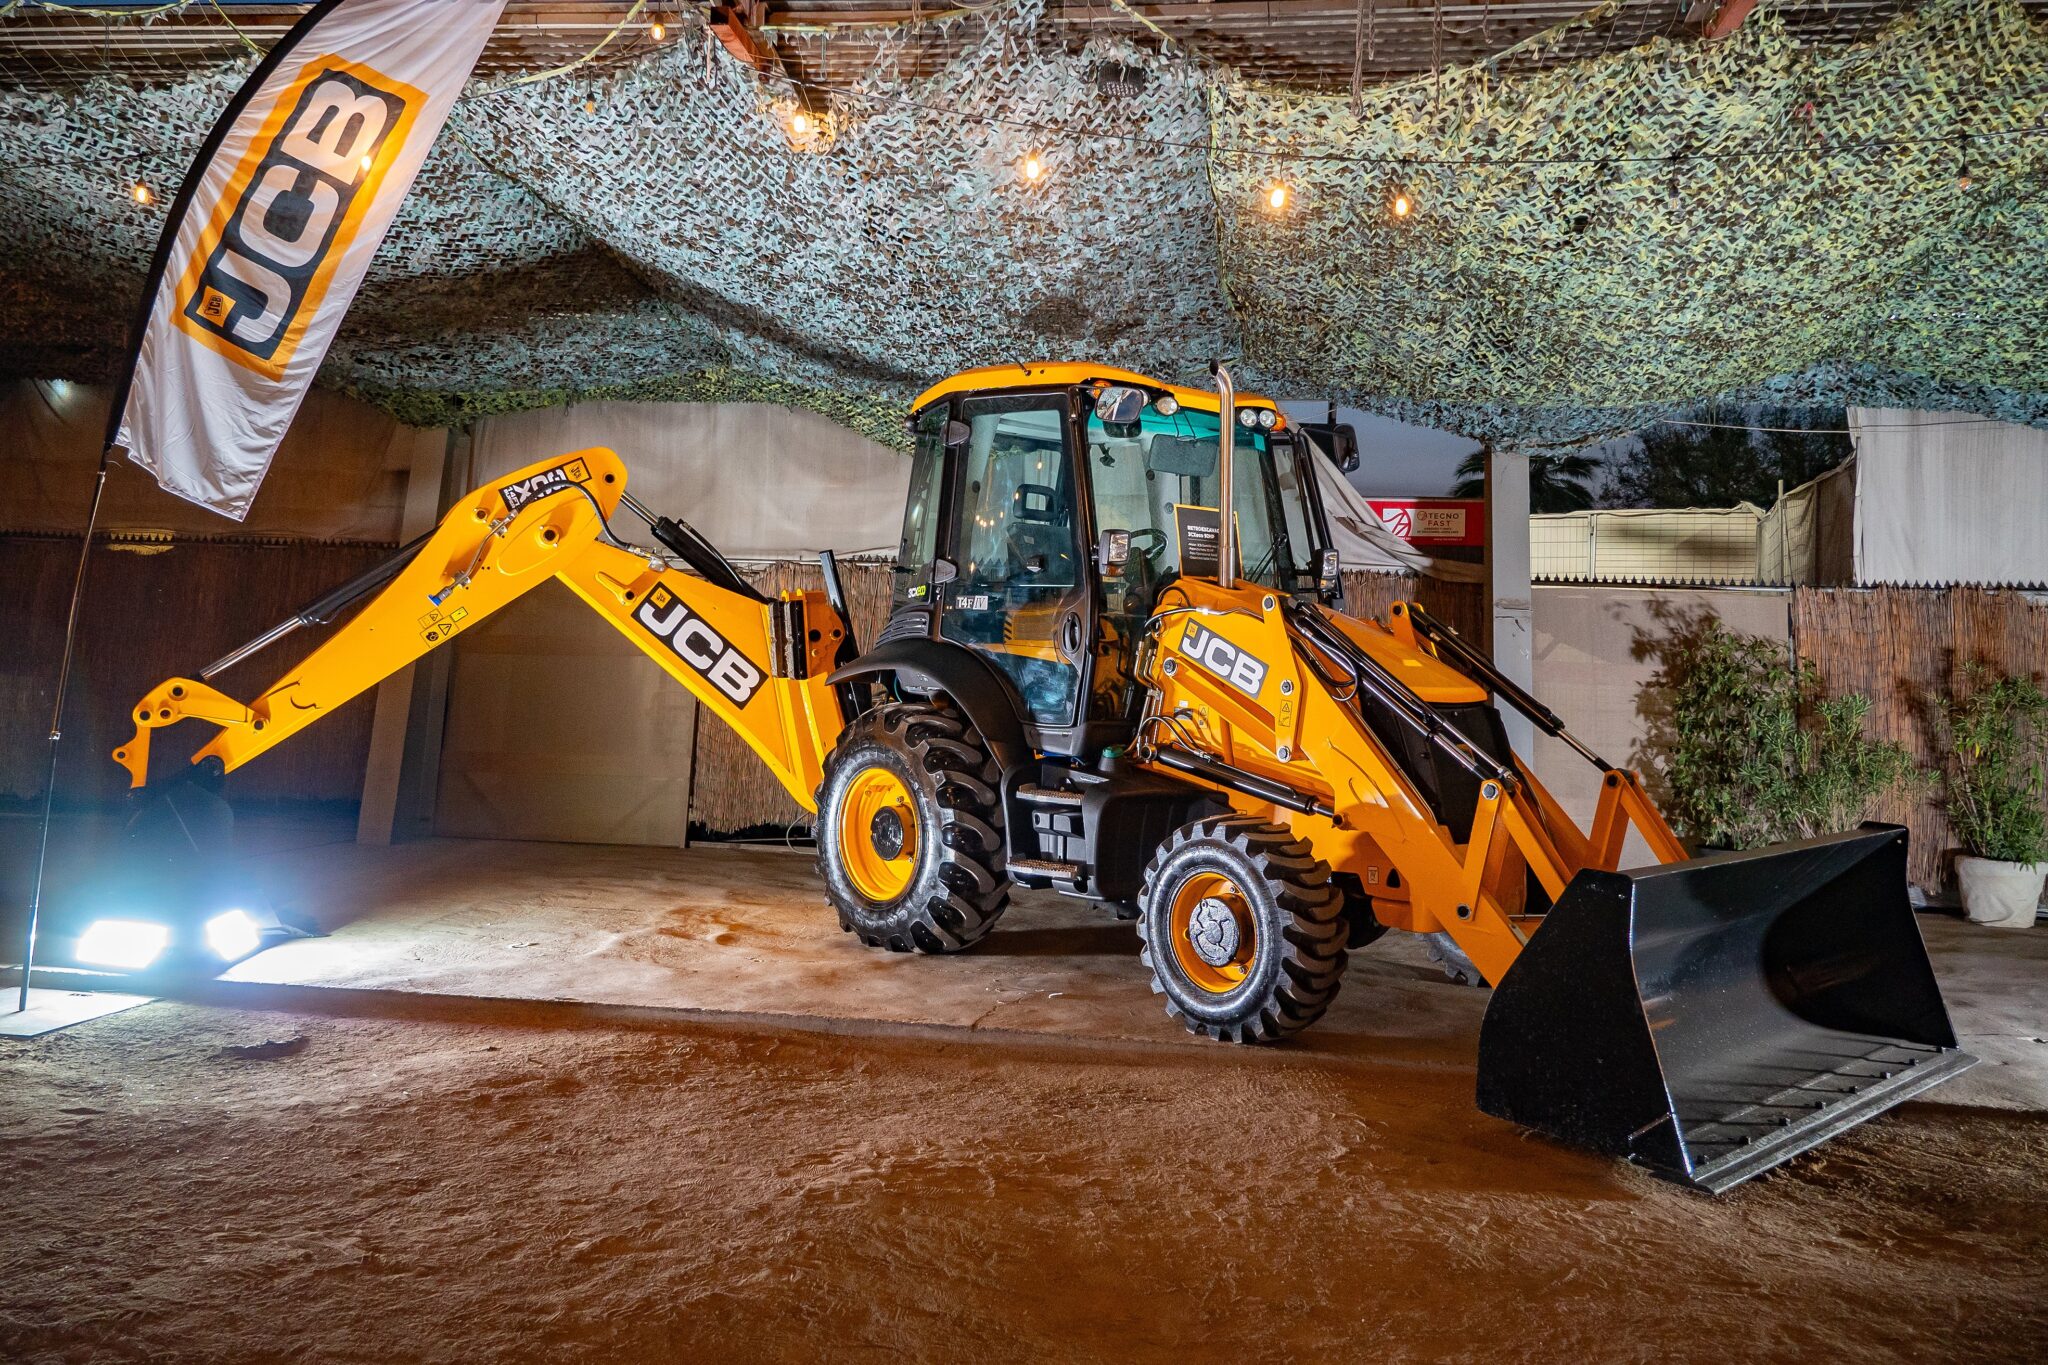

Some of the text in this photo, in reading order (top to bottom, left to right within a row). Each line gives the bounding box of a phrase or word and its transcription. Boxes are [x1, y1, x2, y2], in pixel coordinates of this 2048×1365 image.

[216, 80, 388, 343] JCB
[205, 295, 223, 316] JCB
[1428, 512, 1460, 520] TECNO
[639, 602, 760, 702] JCB
[1181, 629, 1264, 694] JCB
